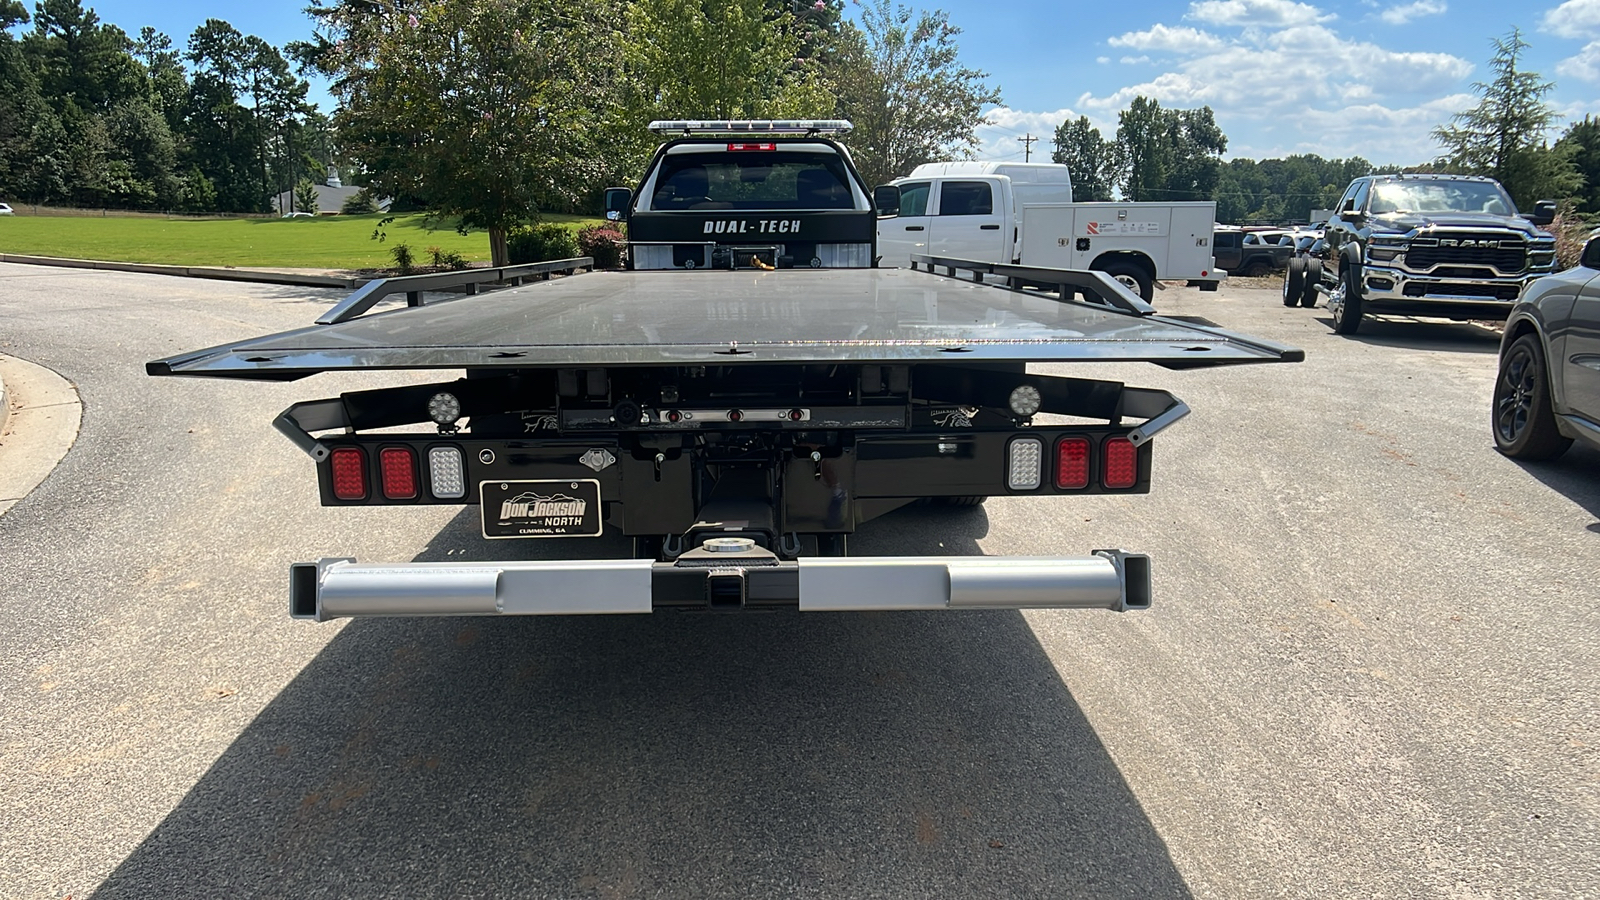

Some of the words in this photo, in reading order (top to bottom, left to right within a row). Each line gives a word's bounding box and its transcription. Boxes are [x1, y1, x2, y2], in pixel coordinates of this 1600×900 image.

[703, 220, 801, 234] DUAL-TECH
[1439, 238, 1498, 249] RAM
[500, 502, 528, 520] DON
[529, 501, 586, 517] JACKSON
[544, 517, 582, 527] NORTH
